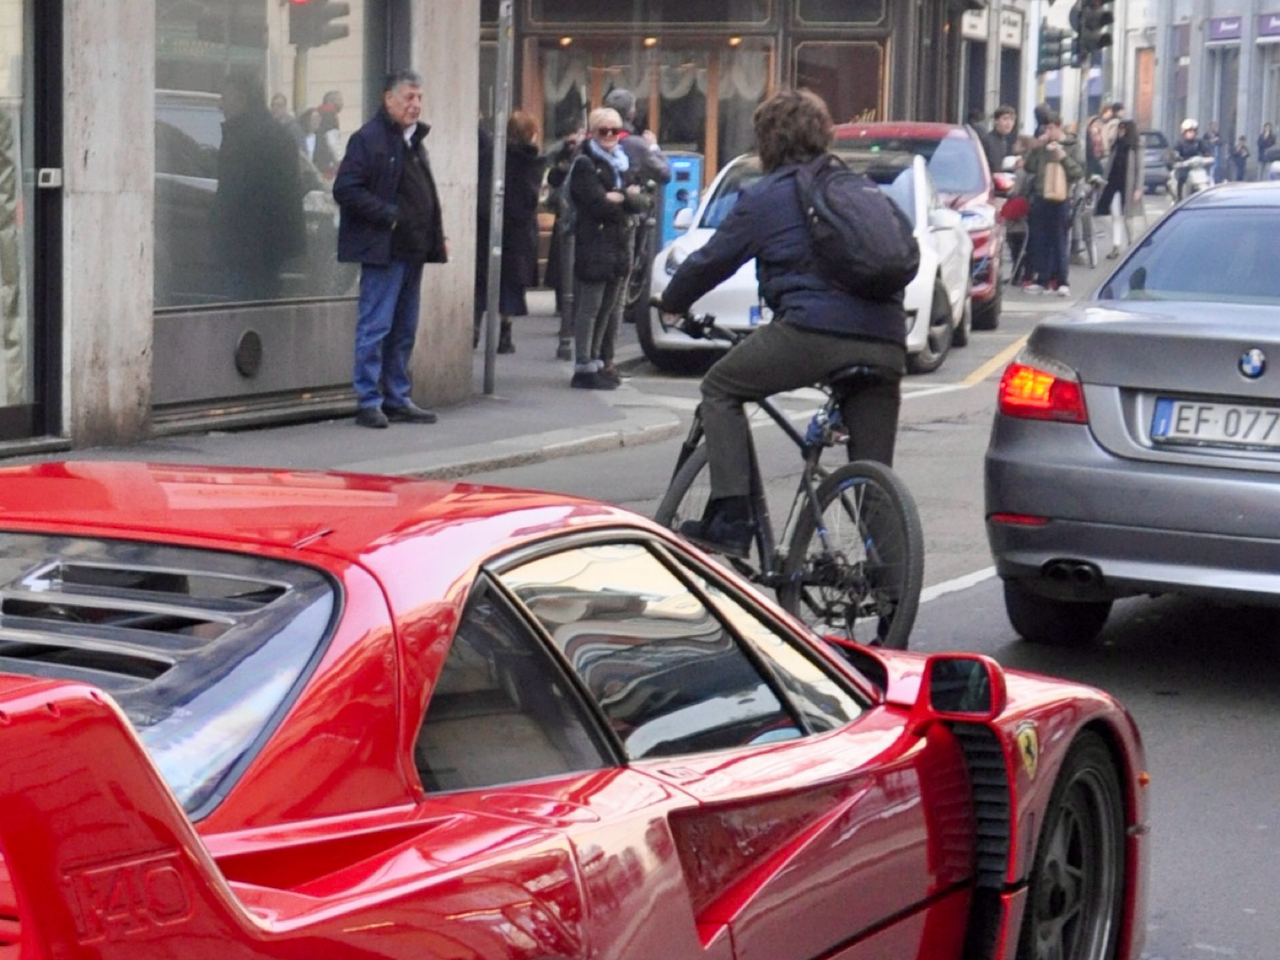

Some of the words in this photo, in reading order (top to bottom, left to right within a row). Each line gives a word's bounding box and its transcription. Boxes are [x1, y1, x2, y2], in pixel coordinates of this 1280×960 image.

[1175, 404, 1215, 435] EF
[1223, 408, 1280, 441] 077
[61, 849, 195, 944] F40
